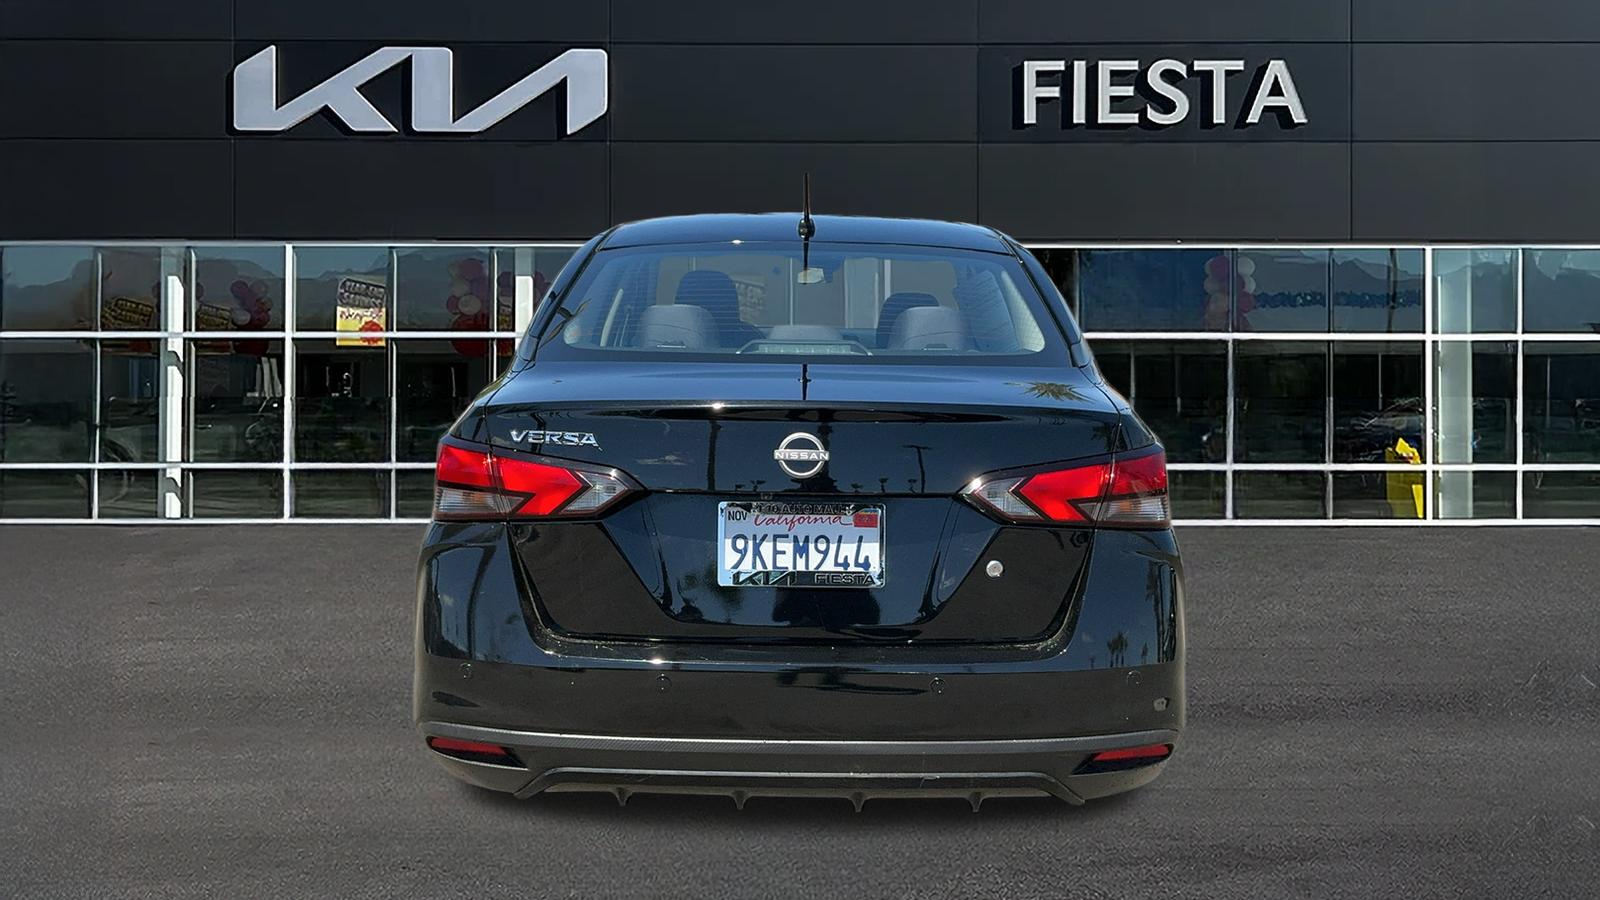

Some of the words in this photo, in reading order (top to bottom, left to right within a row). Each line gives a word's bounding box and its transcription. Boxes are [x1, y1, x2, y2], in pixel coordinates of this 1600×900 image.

[234, 45, 608, 135] KIA
[1023, 59, 1308, 124] FIESTA
[510, 429, 603, 450] VERSA
[774, 451, 829, 460] NISSAN
[728, 511, 748, 521] NOV
[754, 513, 853, 532] California
[731, 533, 872, 570] 9KEM944
[814, 573, 877, 585] FIESTA
